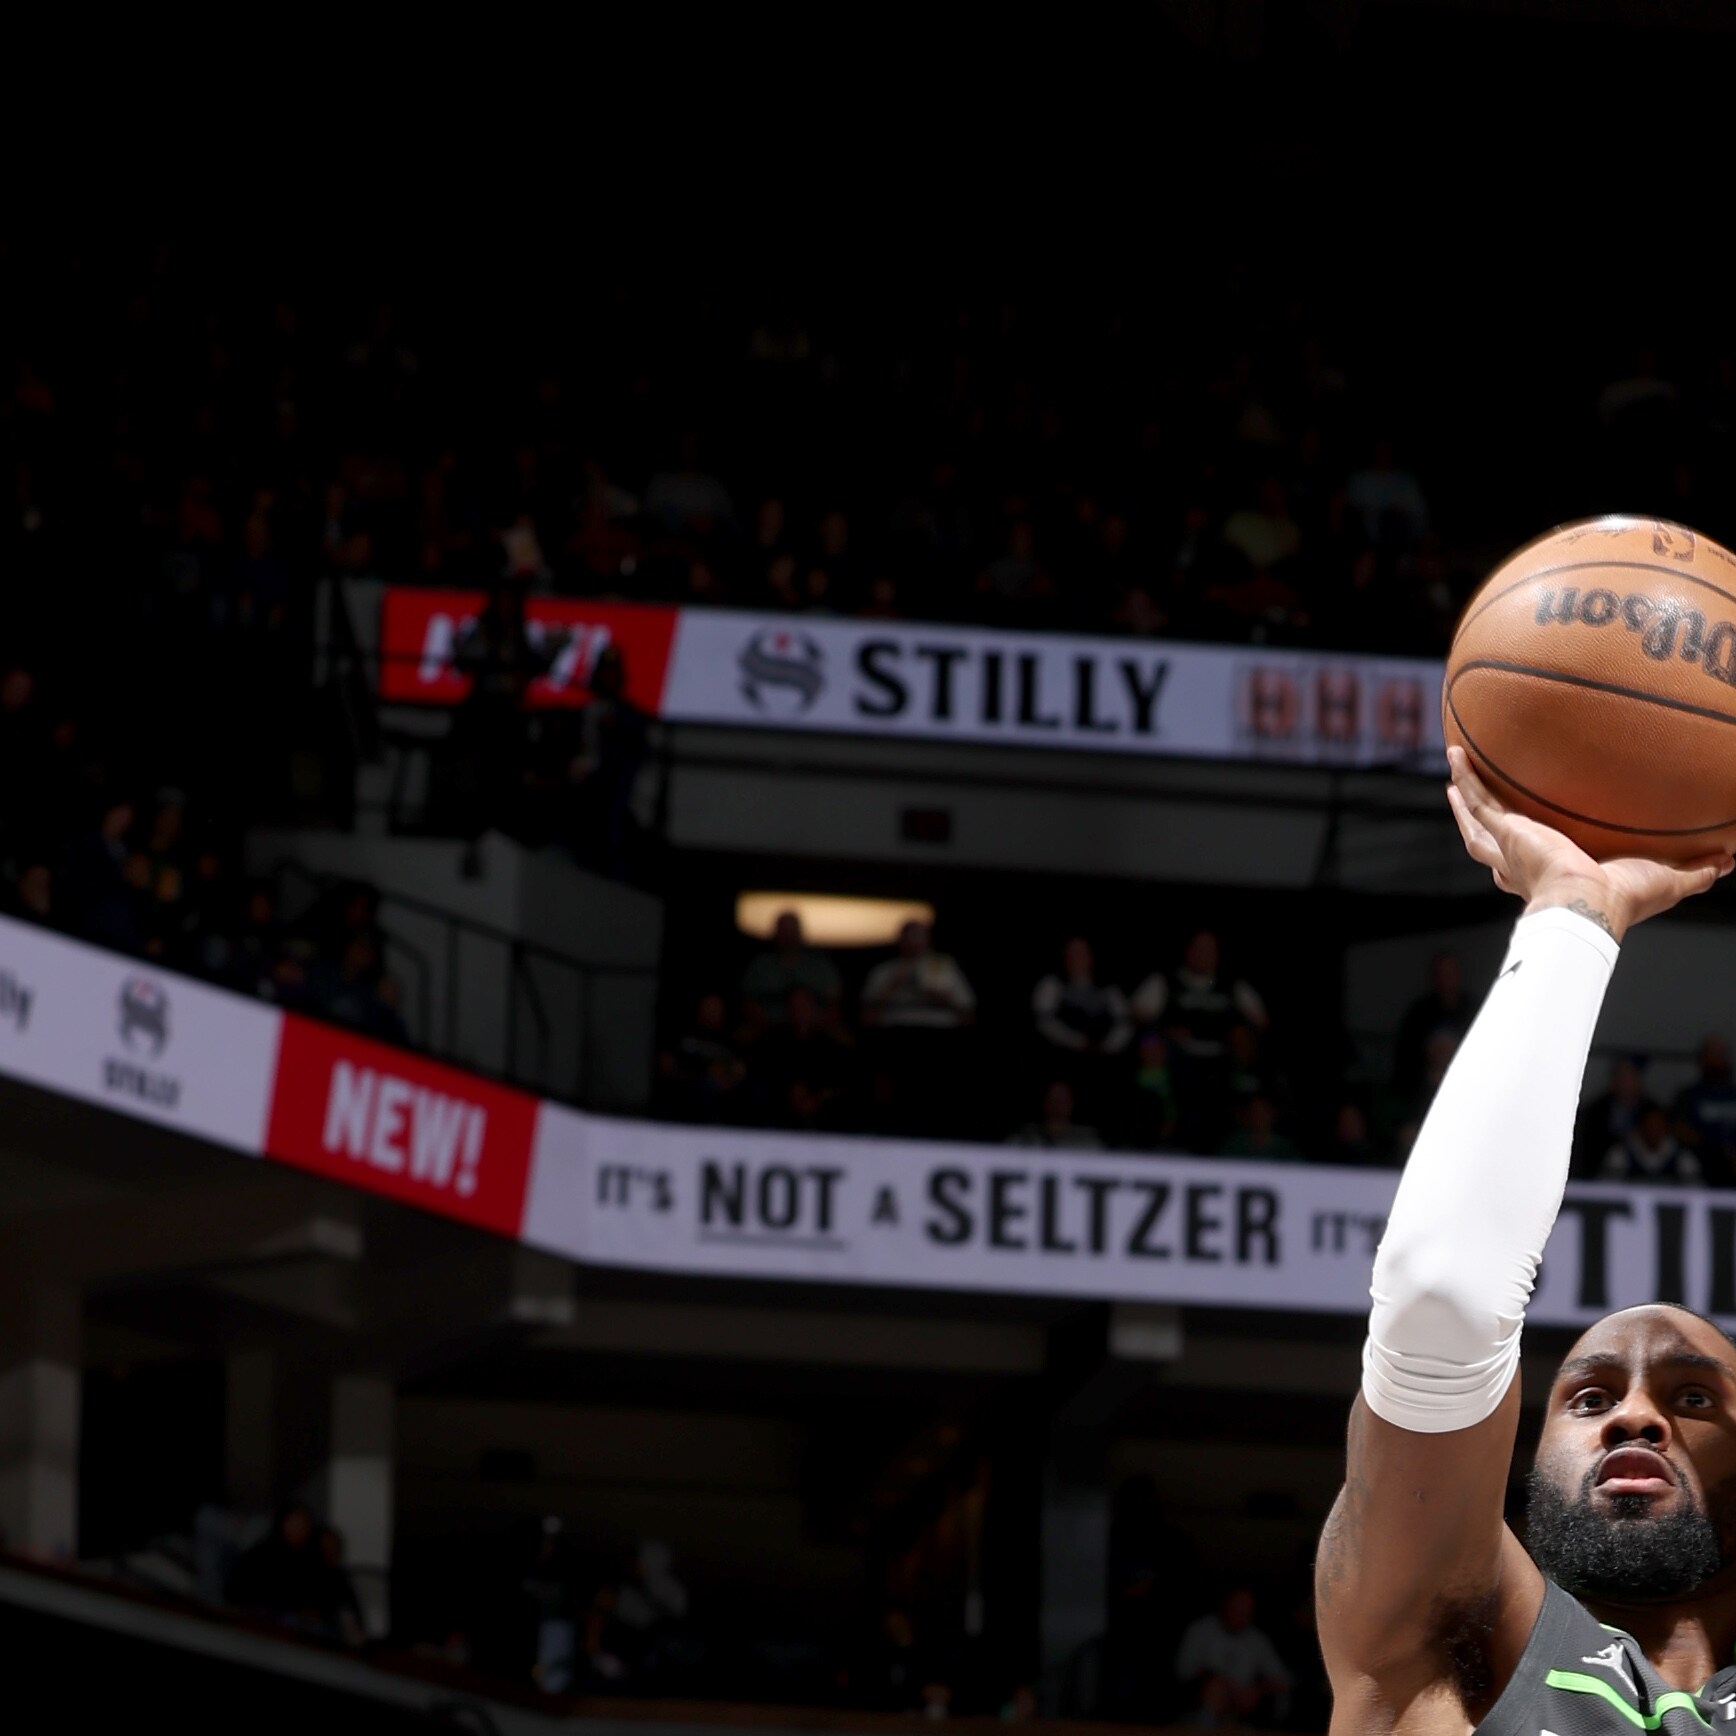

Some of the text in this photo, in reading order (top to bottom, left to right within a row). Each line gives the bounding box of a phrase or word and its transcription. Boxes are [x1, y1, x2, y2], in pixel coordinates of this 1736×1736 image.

[850, 638, 1172, 736] STILLY
[321, 1056, 488, 1196] NEW!
[594, 1164, 674, 1214] IT'S
[699, 1159, 846, 1234] NOT
[869, 1186, 899, 1227] A
[924, 1166, 1284, 1268] SELTZER
